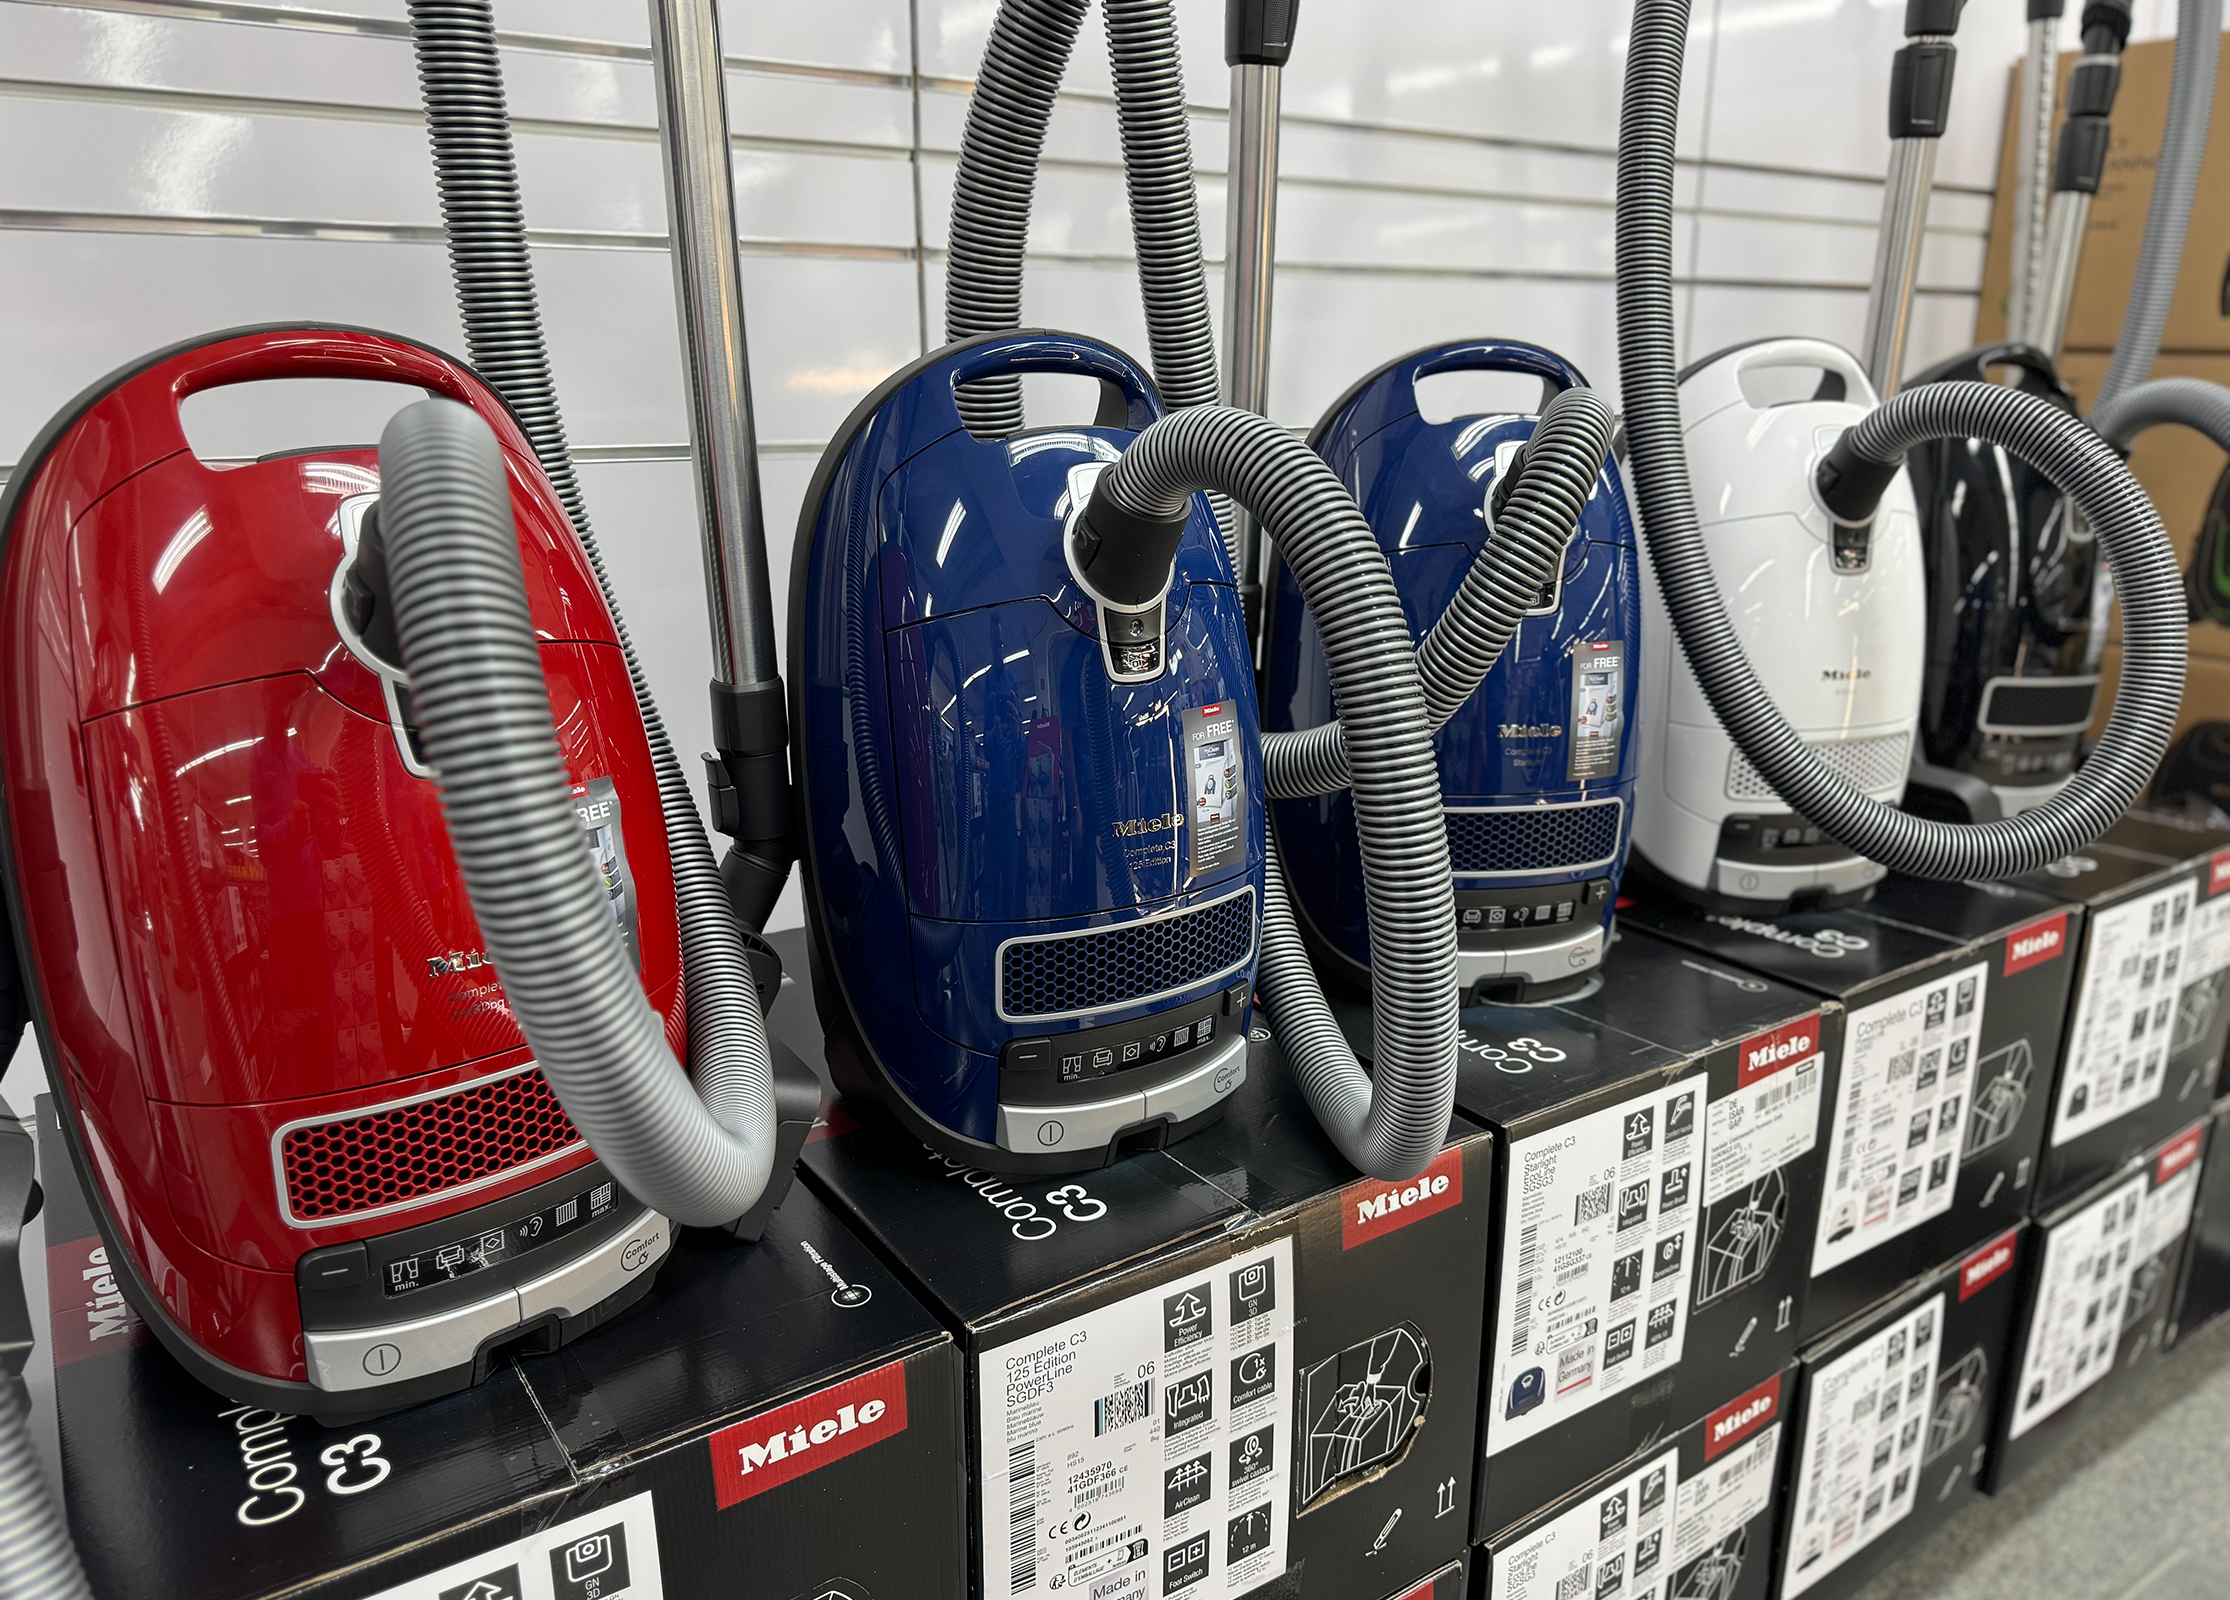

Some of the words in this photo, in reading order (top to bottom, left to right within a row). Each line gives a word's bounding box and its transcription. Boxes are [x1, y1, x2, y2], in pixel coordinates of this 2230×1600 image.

[1192, 732, 1205, 741] FOR
[1497, 723, 1562, 738] Miele
[1112, 813, 1185, 837] Miele
[1124, 844, 1163, 857] Complete
[1165, 840, 1176, 850] C3
[1129, 860, 1143, 870] 125
[1145, 857, 1172, 867] Edition
[1814, 929, 1870, 950] C3
[2012, 930, 2060, 961] Miele
[1857, 1009, 1906, 1038] Complete
[1909, 999, 1924, 1018] C3
[1507, 1037, 1567, 1063] C3
[1748, 1036, 1811, 1071] Miele
[1063, 1072, 1080, 1081] min.
[1217, 1065, 1240, 1084] Comfort
[1524, 1141, 1563, 1163] Complete
[1564, 1135, 1576, 1149] C3
[1631, 1139, 1644, 1150] Power
[1524, 1155, 1557, 1175] Starlight
[1524, 1165, 1556, 1185] EcoLine
[1603, 1166, 1616, 1181] 06
[1523, 1175, 1554, 1195] SGSG3
[1046, 1184, 1108, 1221] C3
[1357, 1173, 1450, 1226] Miele
[591, 1205, 612, 1218] max.
[1622, 1212, 1643, 1227] Integrated
[625, 1232, 660, 1260] Comfort
[800, 1240, 824, 1264] Filtration
[395, 1280, 419, 1292] min.
[820, 1262, 849, 1291] Multistage
[83, 1247, 129, 1341] Miele
[1248, 1298, 1257, 1308] GN
[1249, 1307, 1257, 1317] 3D
[1174, 1331, 1203, 1347] Efficiency
[1179, 1323, 1198, 1336] Power
[1005, 1341, 1066, 1370] Complete
[1070, 1330, 1087, 1346] C3
[1560, 1348, 1585, 1369] Made
[1586, 1345, 1595, 1356] in
[1606, 1353, 1616, 1365] Foot
[1617, 1350, 1629, 1362] Switch
[1006, 1366, 1030, 1383] 125
[1034, 1351, 1076, 1374] Edition
[1137, 1361, 1155, 1378] 06
[1254, 1357, 1265, 1368] 1x
[1558, 1360, 1593, 1383] Germany
[1006, 1364, 1073, 1396] PowerLine
[1006, 1381, 1054, 1408] SGDF3
[1233, 1388, 1256, 1404] Comfort
[1257, 1382, 1273, 1393] cable
[1006, 1401, 1040, 1416] Marineblau
[1006, 1412, 1021, 1423] Bleu
[1021, 1406, 1042, 1418] marine
[1006, 1412, 1044, 1429] Marineblauw
[1006, 1425, 1027, 1436] Marine
[1029, 1420, 1042, 1429] blue
[1173, 1410, 1204, 1429] Integrated
[1714, 1396, 1772, 1442] Miele
[739, 1399, 887, 1475] Miele
[1006, 1435, 1016, 1443] blu
[1017, 1428, 1038, 1439] marino
[320, 1433, 391, 1494] C3
[1067, 1456, 1085, 1468] HS15
[1243, 1461, 1258, 1474] 360°
[1067, 1468, 1116, 1493] 41GDF366
[1119, 1465, 1128, 1473] CE
[1068, 1461, 1113, 1484] 12435970
[1231, 1473, 1249, 1487] swivel
[1250, 1464, 1270, 1479] castors
[1175, 1493, 1200, 1510] AirClean
[1242, 1545, 1250, 1554] 12
[1251, 1542, 1257, 1550] m
[1508, 1540, 1543, 1566] Complete
[1545, 1532, 1556, 1545] C3
[1582, 1550, 1593, 1563] 06
[1508, 1552, 1538, 1574] Starlight
[585, 1576, 599, 1591] GN
[1169, 1577, 1183, 1589] Foot
[1183, 1568, 1203, 1583] Switch
[1507, 1572, 1536, 1593] SGSG3
[1508, 1563, 1537, 1585] EcoLine
[586, 1588, 600, 1600] 3D
[1094, 1577, 1131, 1600] Made
[1135, 1569, 1146, 1582] in
